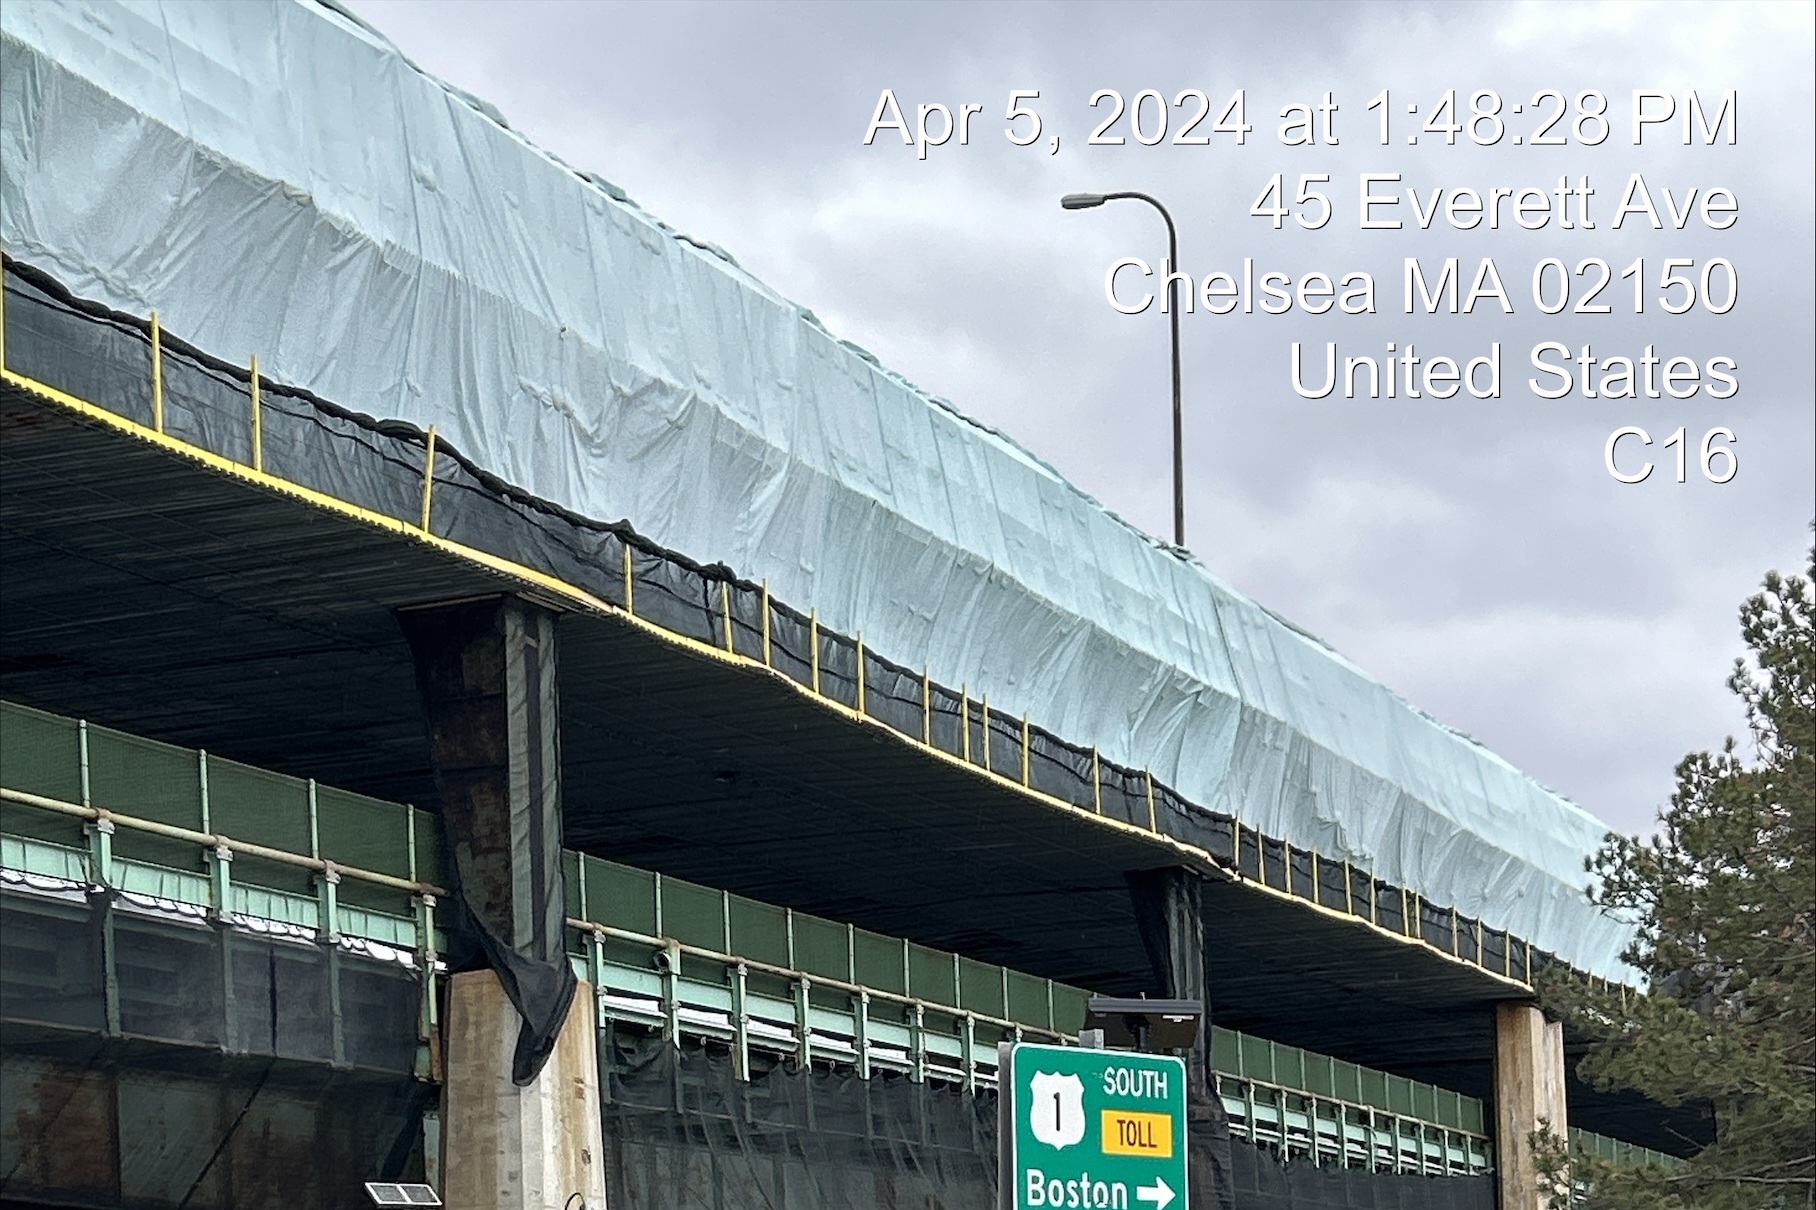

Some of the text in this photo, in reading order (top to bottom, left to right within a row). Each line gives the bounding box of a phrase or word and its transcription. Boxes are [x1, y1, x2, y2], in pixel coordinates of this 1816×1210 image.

[1102, 1066, 1169, 1099] SOUTH
[1053, 1091, 1061, 1132] 1
[1116, 1119, 1158, 1149] TOLL
[1026, 1168, 1128, 1210] Boston
